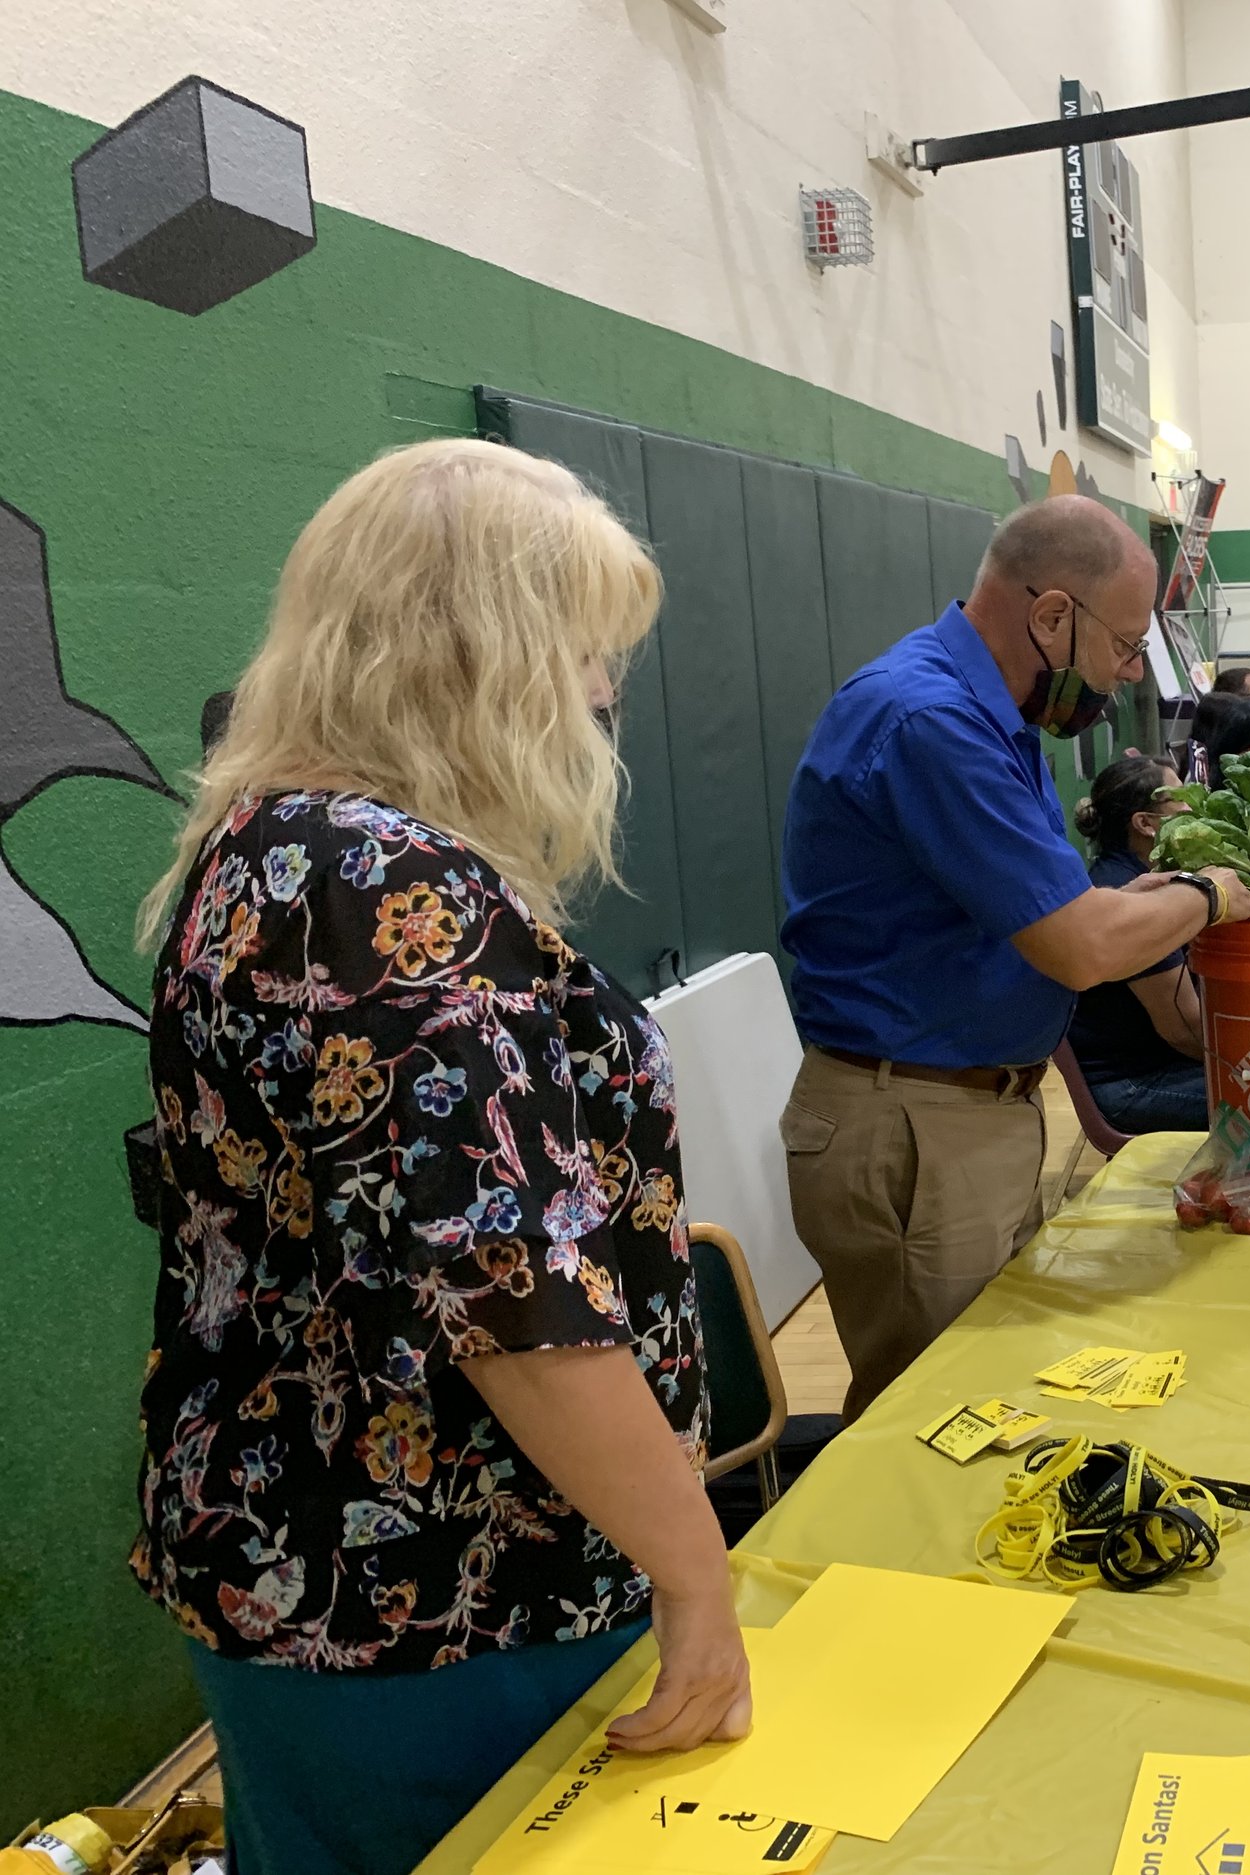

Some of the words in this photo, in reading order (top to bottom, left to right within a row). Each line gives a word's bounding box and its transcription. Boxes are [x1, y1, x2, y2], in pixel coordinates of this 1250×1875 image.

[524, 1781, 590, 1834] These
[579, 1750, 614, 1776] Str
[1142, 1774, 1182, 1845] Santas!
